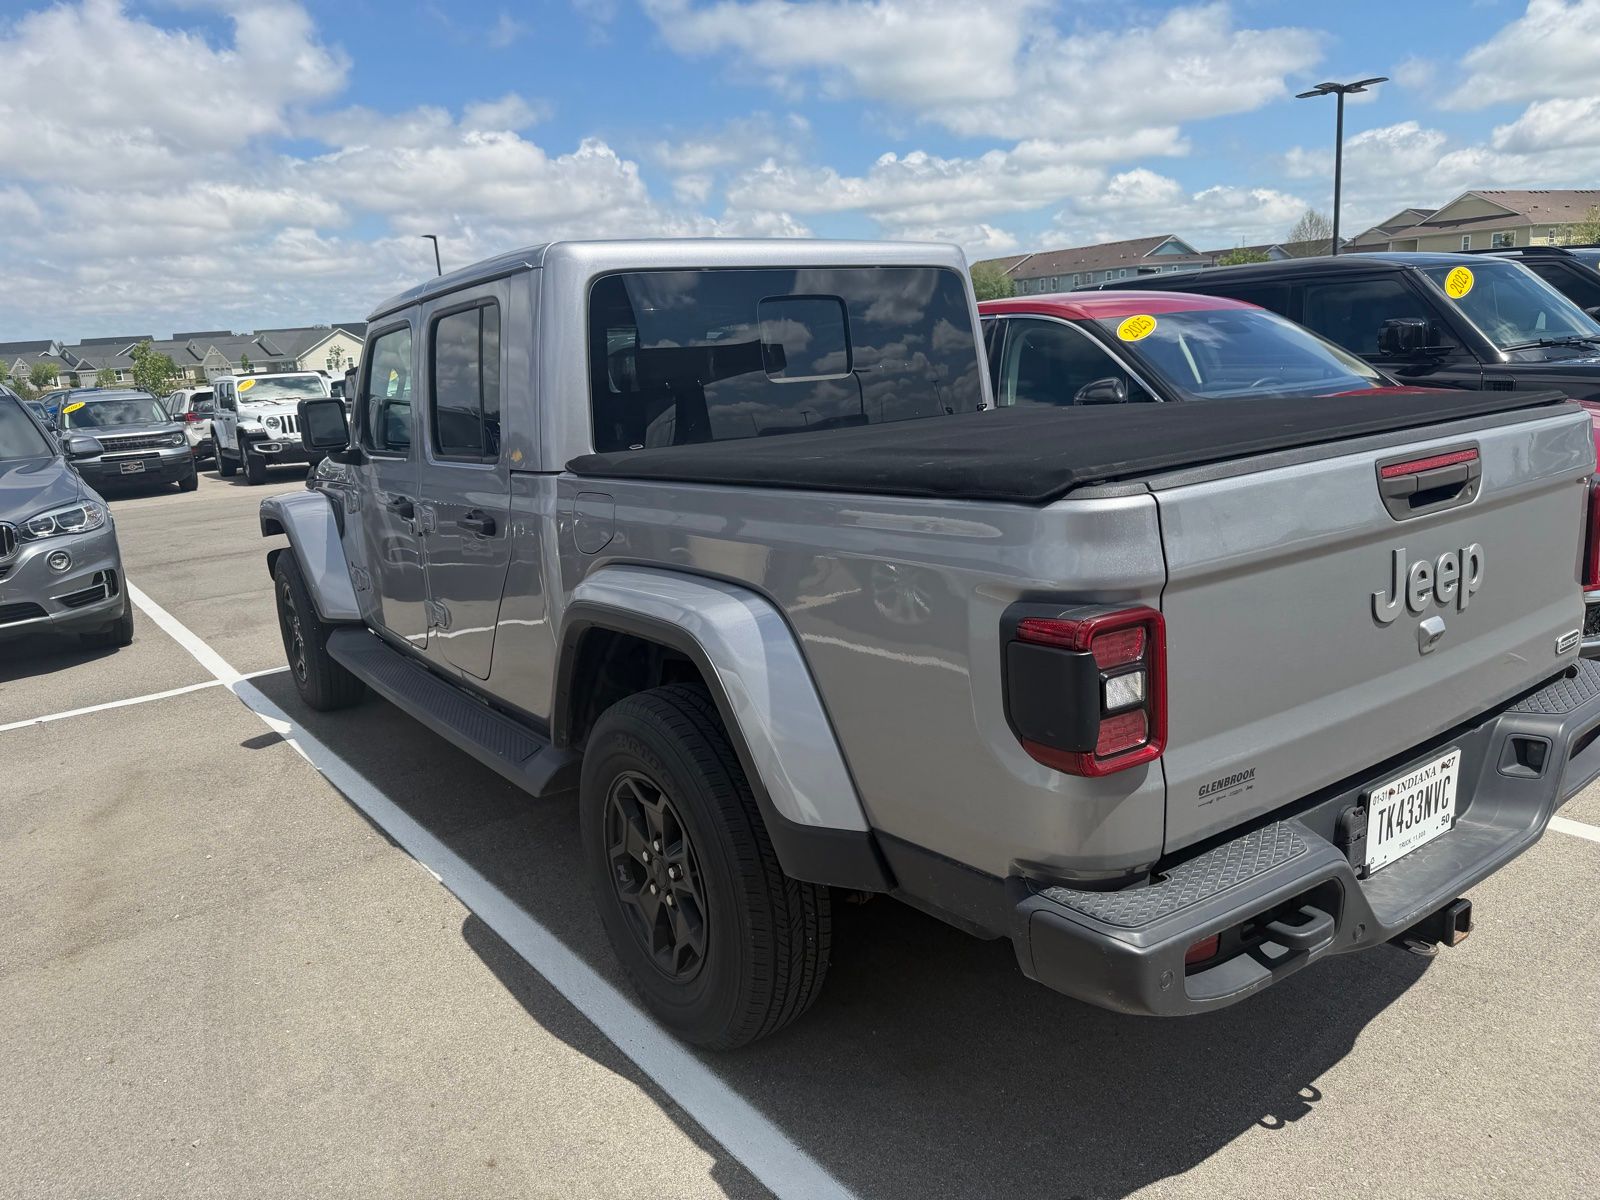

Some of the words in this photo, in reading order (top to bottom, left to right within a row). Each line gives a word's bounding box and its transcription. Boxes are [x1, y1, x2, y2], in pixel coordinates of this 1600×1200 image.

[1450, 269, 1469, 295] 2023
[1123, 317, 1152, 338] 2025
[1372, 543, 1485, 624] Jeep
[1199, 767, 1256, 797] GLENBROOK
[1396, 766, 1437, 795] INDIANA
[1378, 775, 1451, 845] TK433NVC
[1440, 813, 1450, 826] 50
